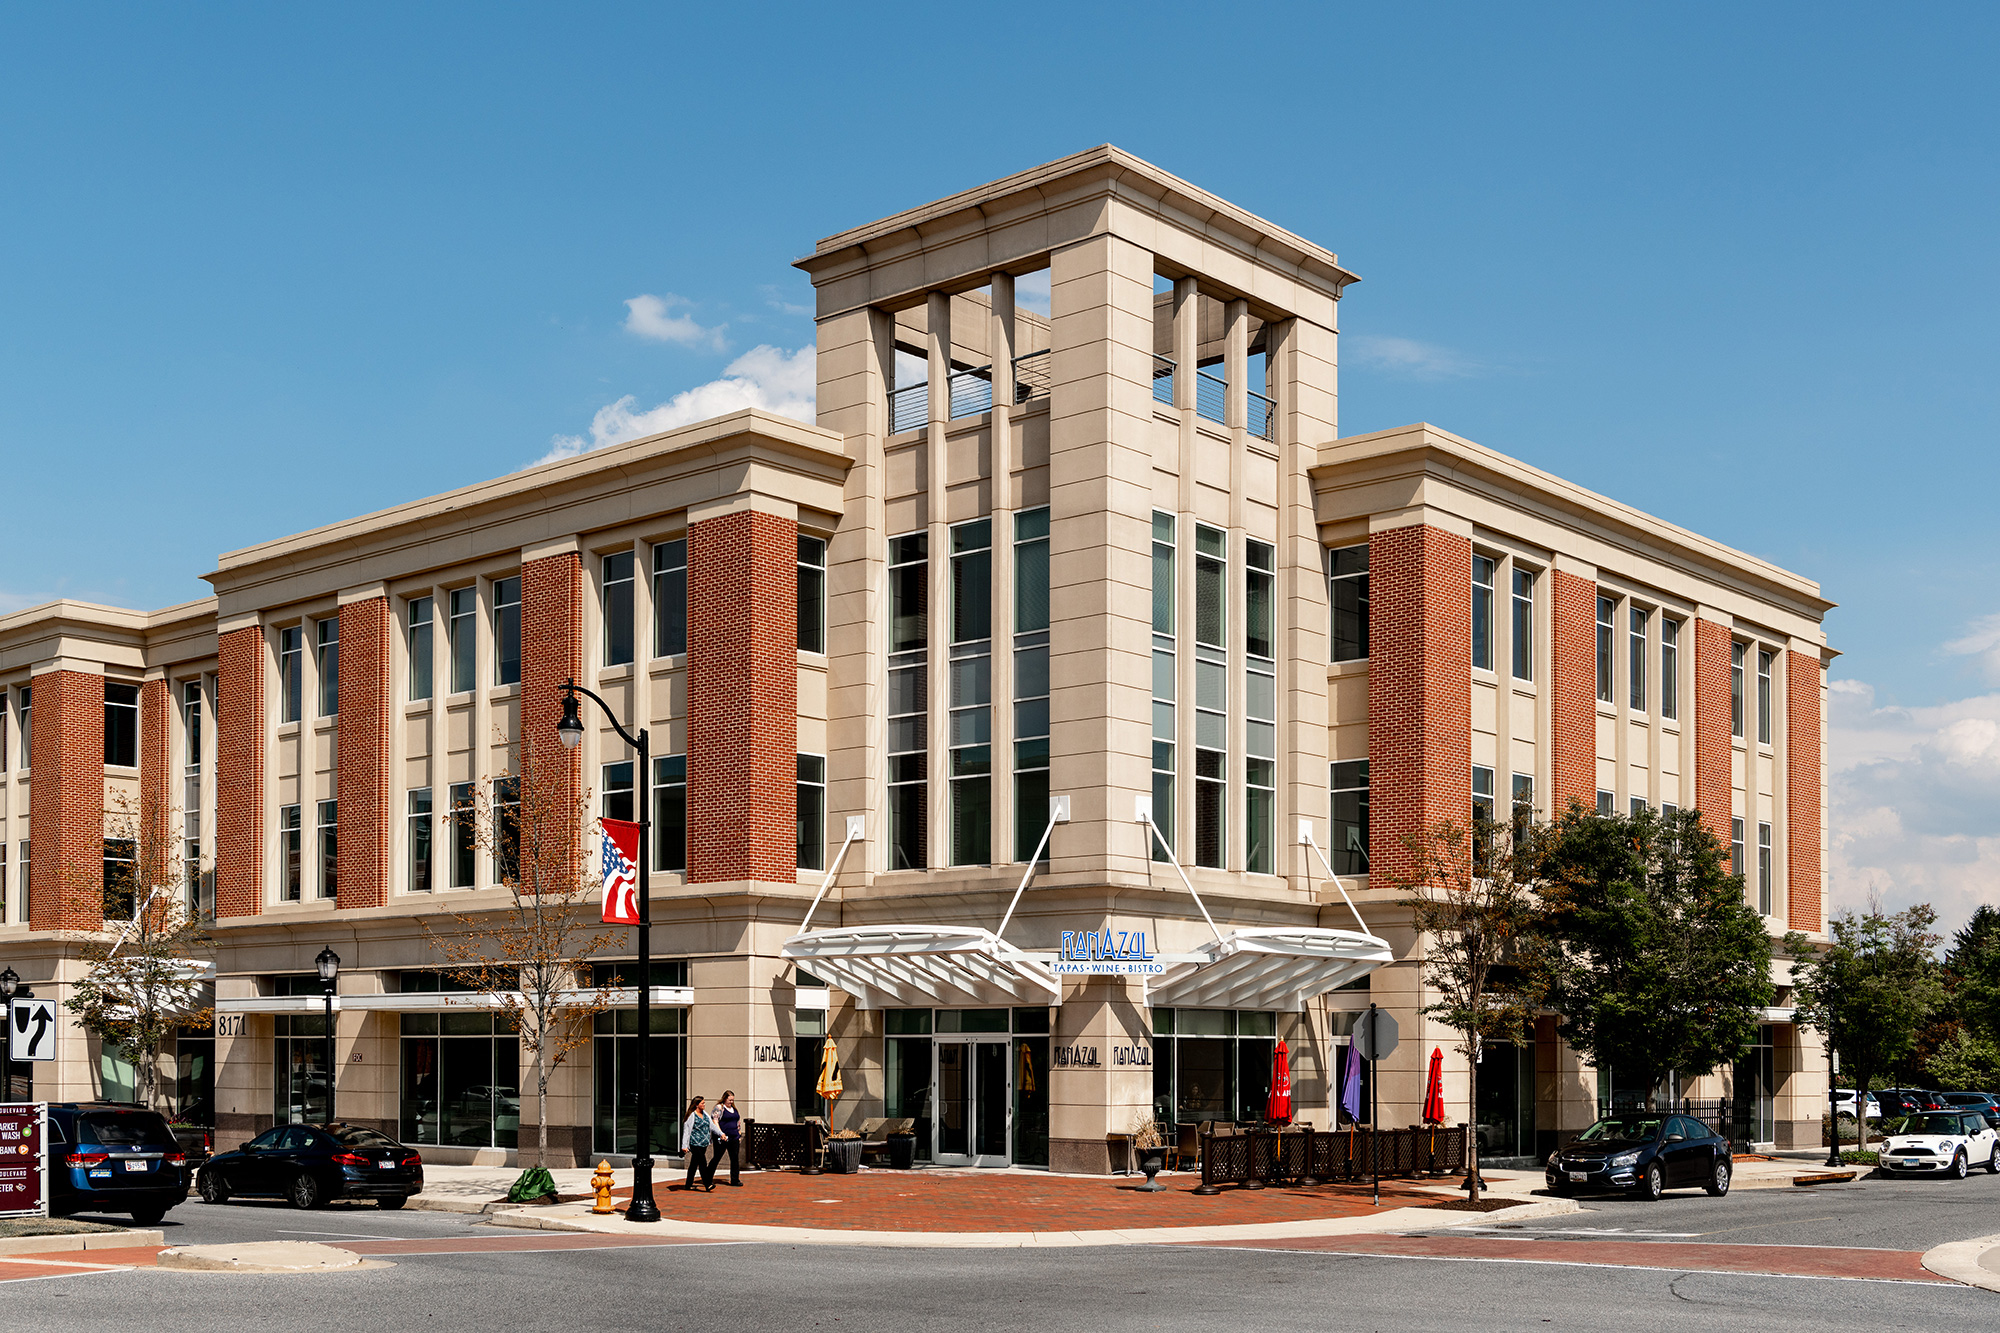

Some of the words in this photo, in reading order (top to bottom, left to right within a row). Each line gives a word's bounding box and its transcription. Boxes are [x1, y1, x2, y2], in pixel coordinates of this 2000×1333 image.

[1054, 964, 1085, 973] TAPAS
[1092, 964, 1120, 973] WINE
[1128, 964, 1163, 973] BISTRO
[218, 1015, 247, 1036] 8171
[1, 1131, 20, 1140] WASH
[0, 1146, 16, 1155] BANK
